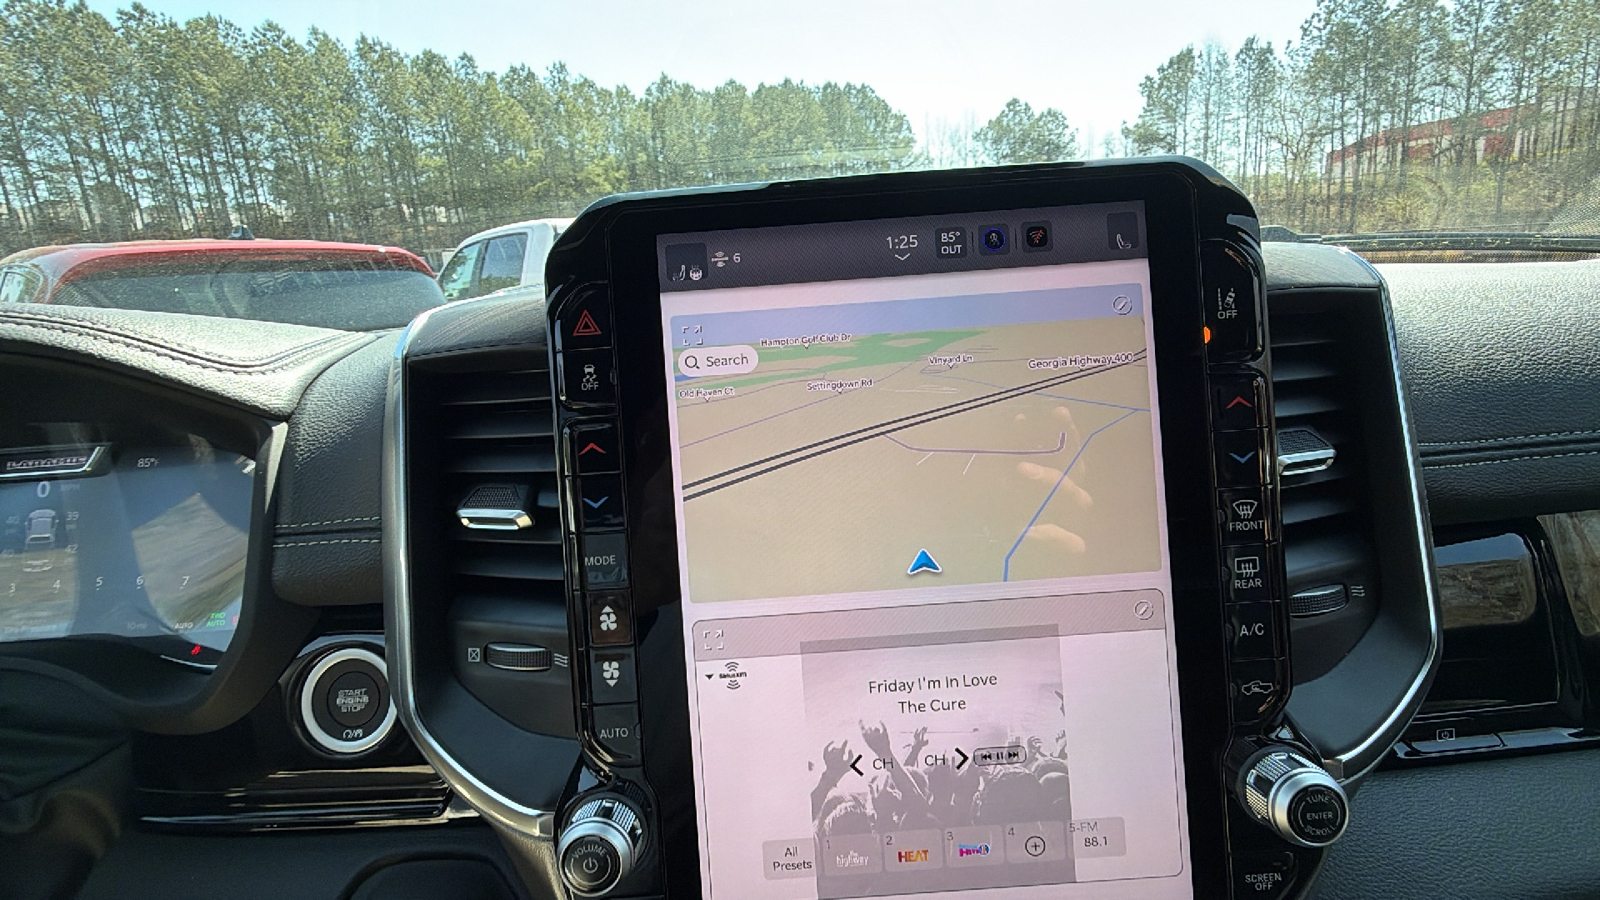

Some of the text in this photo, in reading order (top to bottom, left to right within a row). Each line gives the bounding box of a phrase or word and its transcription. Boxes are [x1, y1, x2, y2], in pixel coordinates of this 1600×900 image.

[886, 234, 918, 249] 1:25
[941, 245, 962, 254] OUT
[733, 252, 741, 263] 6
[1217, 309, 1238, 319] OFF
[760, 333, 851, 347] Hampton Golf Club Dr
[706, 353, 749, 367] Search
[929, 354, 973, 367] Vinyard Ln
[1028, 353, 1133, 369] Georgia Highway 400
[581, 382, 599, 391] OFF
[806, 378, 873, 391] Settingdown Rd
[679, 387, 735, 399] Old Haven Ct
[37, 481, 50, 498] 0
[1229, 519, 1264, 532] FRONT
[584, 555, 617, 566] MODE
[53, 579, 61, 589] 4
[96, 576, 104, 587] 5
[136, 576, 144, 586] 6
[182, 576, 190, 586] 7
[1234, 578, 1262, 589] REAR
[1239, 623, 1265, 637] A/C
[868, 674, 998, 694] Friday I'm In Love
[338, 688, 367, 696] START
[336, 696, 369, 705] ENGINE
[898, 699, 967, 714] The Cure
[600, 727, 629, 739] AUTO
[872, 758, 894, 770] CH
[924, 754, 946, 767] CH
[1306, 794, 1331, 805] TUNE
[1306, 811, 1334, 821] ENTER
[1008, 827, 1015, 837] 4
[1069, 821, 1099, 833] 5-FM
[1304, 824, 1336, 836] SCROLL
[886, 836, 893, 846] 2
[946, 831, 954, 841] 3
[826, 840, 831, 850] 1
[1084, 836, 1108, 848] 88.1
[571, 843, 608, 859] VOLUME
[784, 847, 798, 858] All
[897, 850, 929, 863] HEAT
[773, 860, 812, 871] Presets
[836, 854, 869, 868] highway
[1245, 873, 1282, 883] SCREEN
[1255, 881, 1273, 891] OFF
